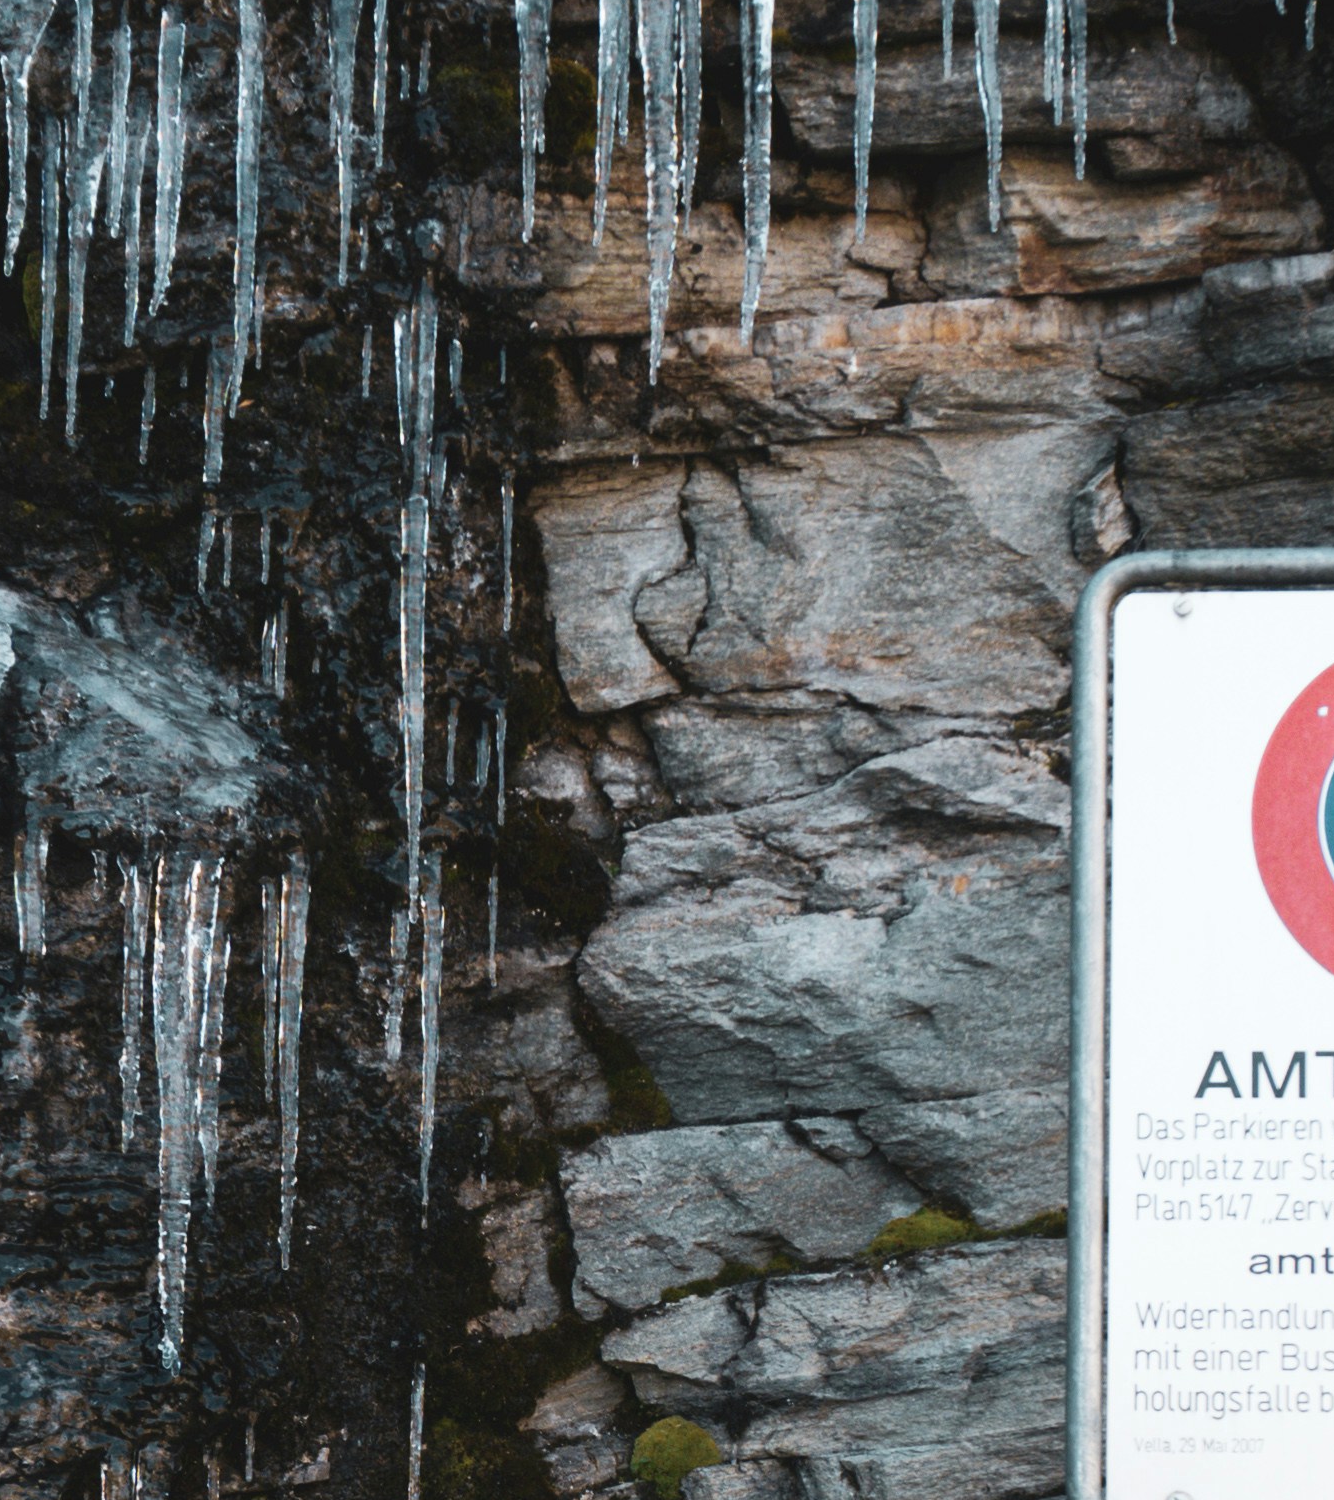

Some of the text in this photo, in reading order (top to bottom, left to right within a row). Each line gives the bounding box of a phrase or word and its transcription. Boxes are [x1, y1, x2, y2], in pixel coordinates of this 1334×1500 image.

[1136, 1112, 1186, 1141] Das
[1193, 1111, 1323, 1141] Parkieren
[1136, 1153, 1244, 1186] Vorplatz
[1252, 1159, 1293, 1181] zur
[1135, 1193, 1192, 1222] Plan
[1199, 1193, 1253, 1222] 5147
[1134, 1341, 1182, 1371] mit
[1192, 1341, 1270, 1372] einer
[1134, 1383, 1311, 1420] holungsfalle
[1133, 1436, 1176, 1454] Vella,
